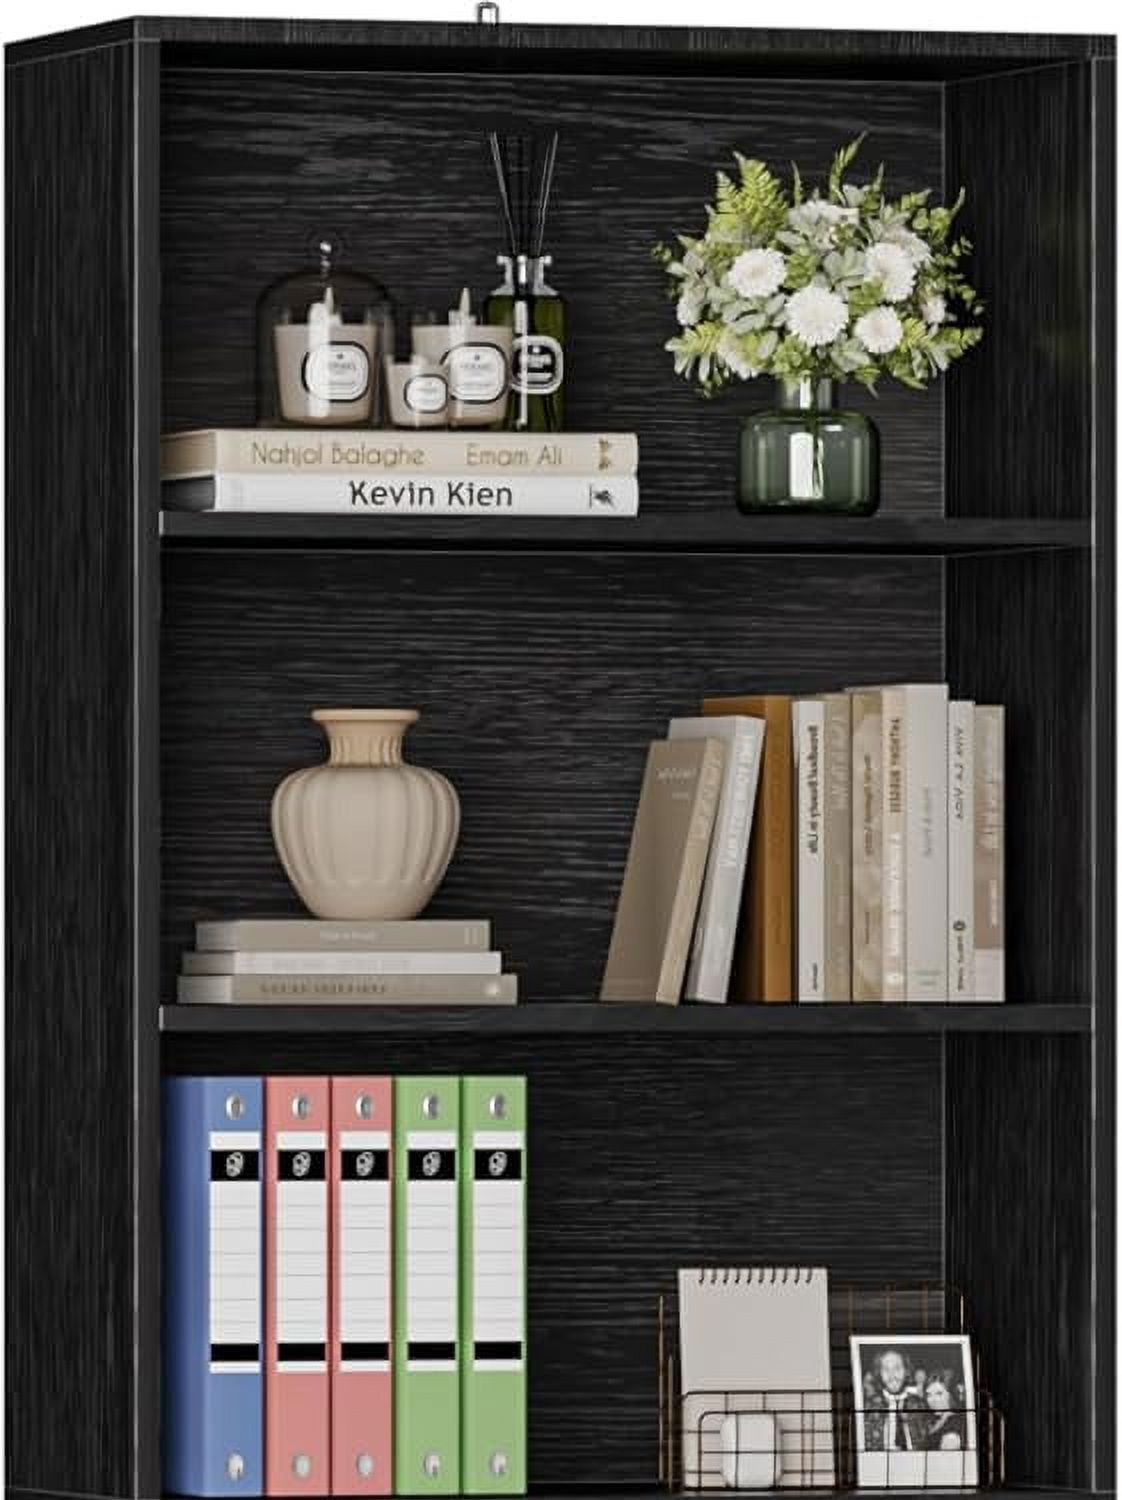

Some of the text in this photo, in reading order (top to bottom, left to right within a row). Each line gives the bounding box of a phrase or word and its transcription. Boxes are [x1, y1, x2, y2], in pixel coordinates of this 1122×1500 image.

[253, 441, 563, 468] Nahjol Balaghe Emam Ali
[349, 479, 513, 506] Kevin Kien
